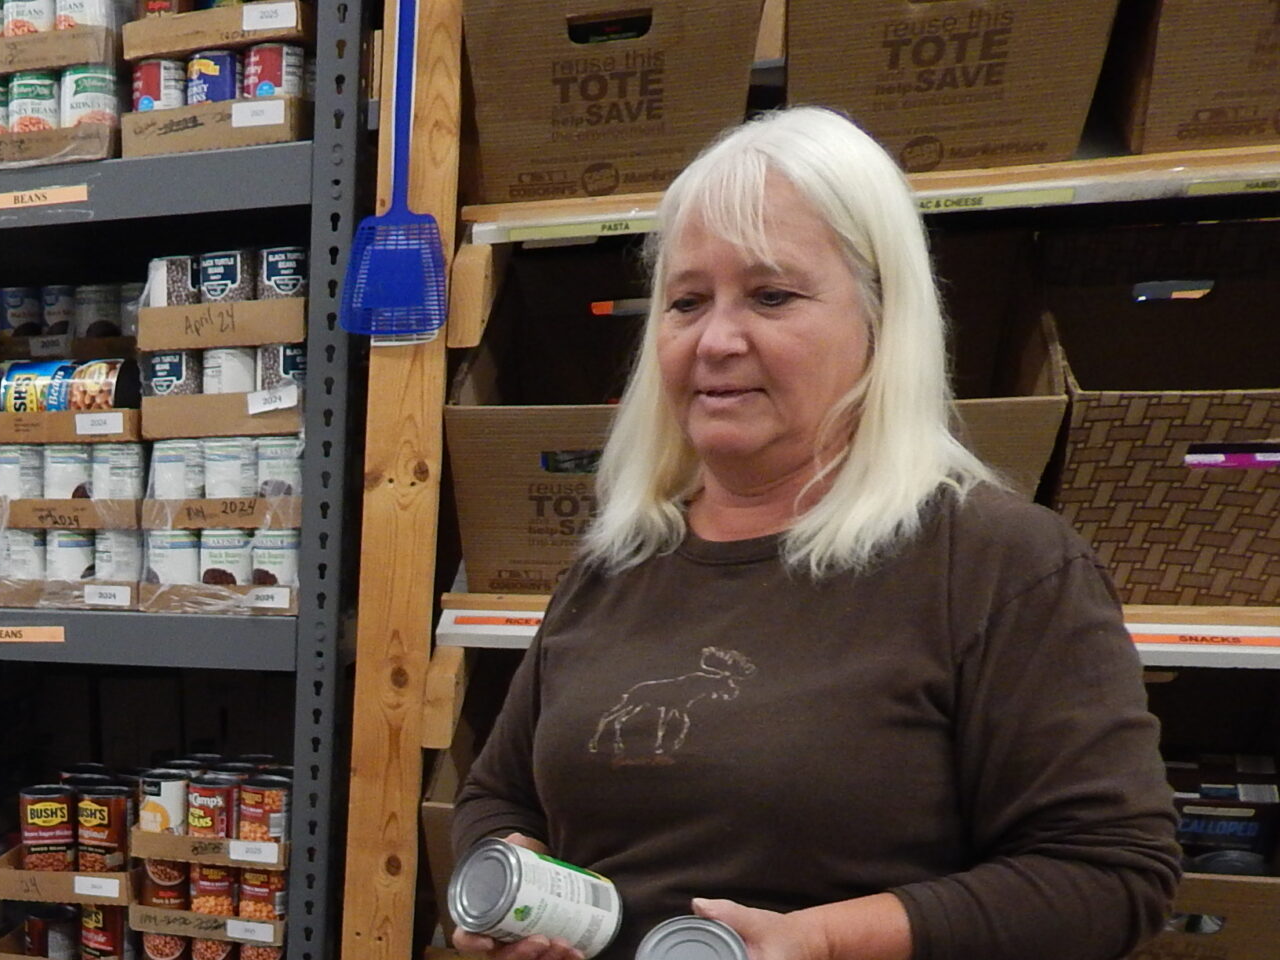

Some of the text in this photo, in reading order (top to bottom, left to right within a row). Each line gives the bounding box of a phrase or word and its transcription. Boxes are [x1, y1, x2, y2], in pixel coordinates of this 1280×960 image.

[883, 7, 1014, 38] reuse this
[883, 27, 1011, 70] TOTE
[552, 50, 666, 75] reuse this
[552, 69, 665, 104] TOTE
[914, 61, 1007, 93] SAVE
[586, 99, 663, 126] SAVE
[12, 192, 48, 205] BEANS
[920, 197, 984, 210] AC & CHEESE
[600, 221, 630, 232] PASTA
[184, 303, 236, 336] April 24
[13, 374, 33, 413] SH'S
[527, 481, 585, 496] reuse
[221, 500, 257, 516] 2024
[528, 496, 598, 518] TOT
[559, 518, 589, 536] SA
[1178, 635, 1242, 645] SNACKS
[29, 805, 66, 820] BUSH'S
[78, 807, 107, 823] USH'S
[1179, 818, 1259, 838] CALLOPED
